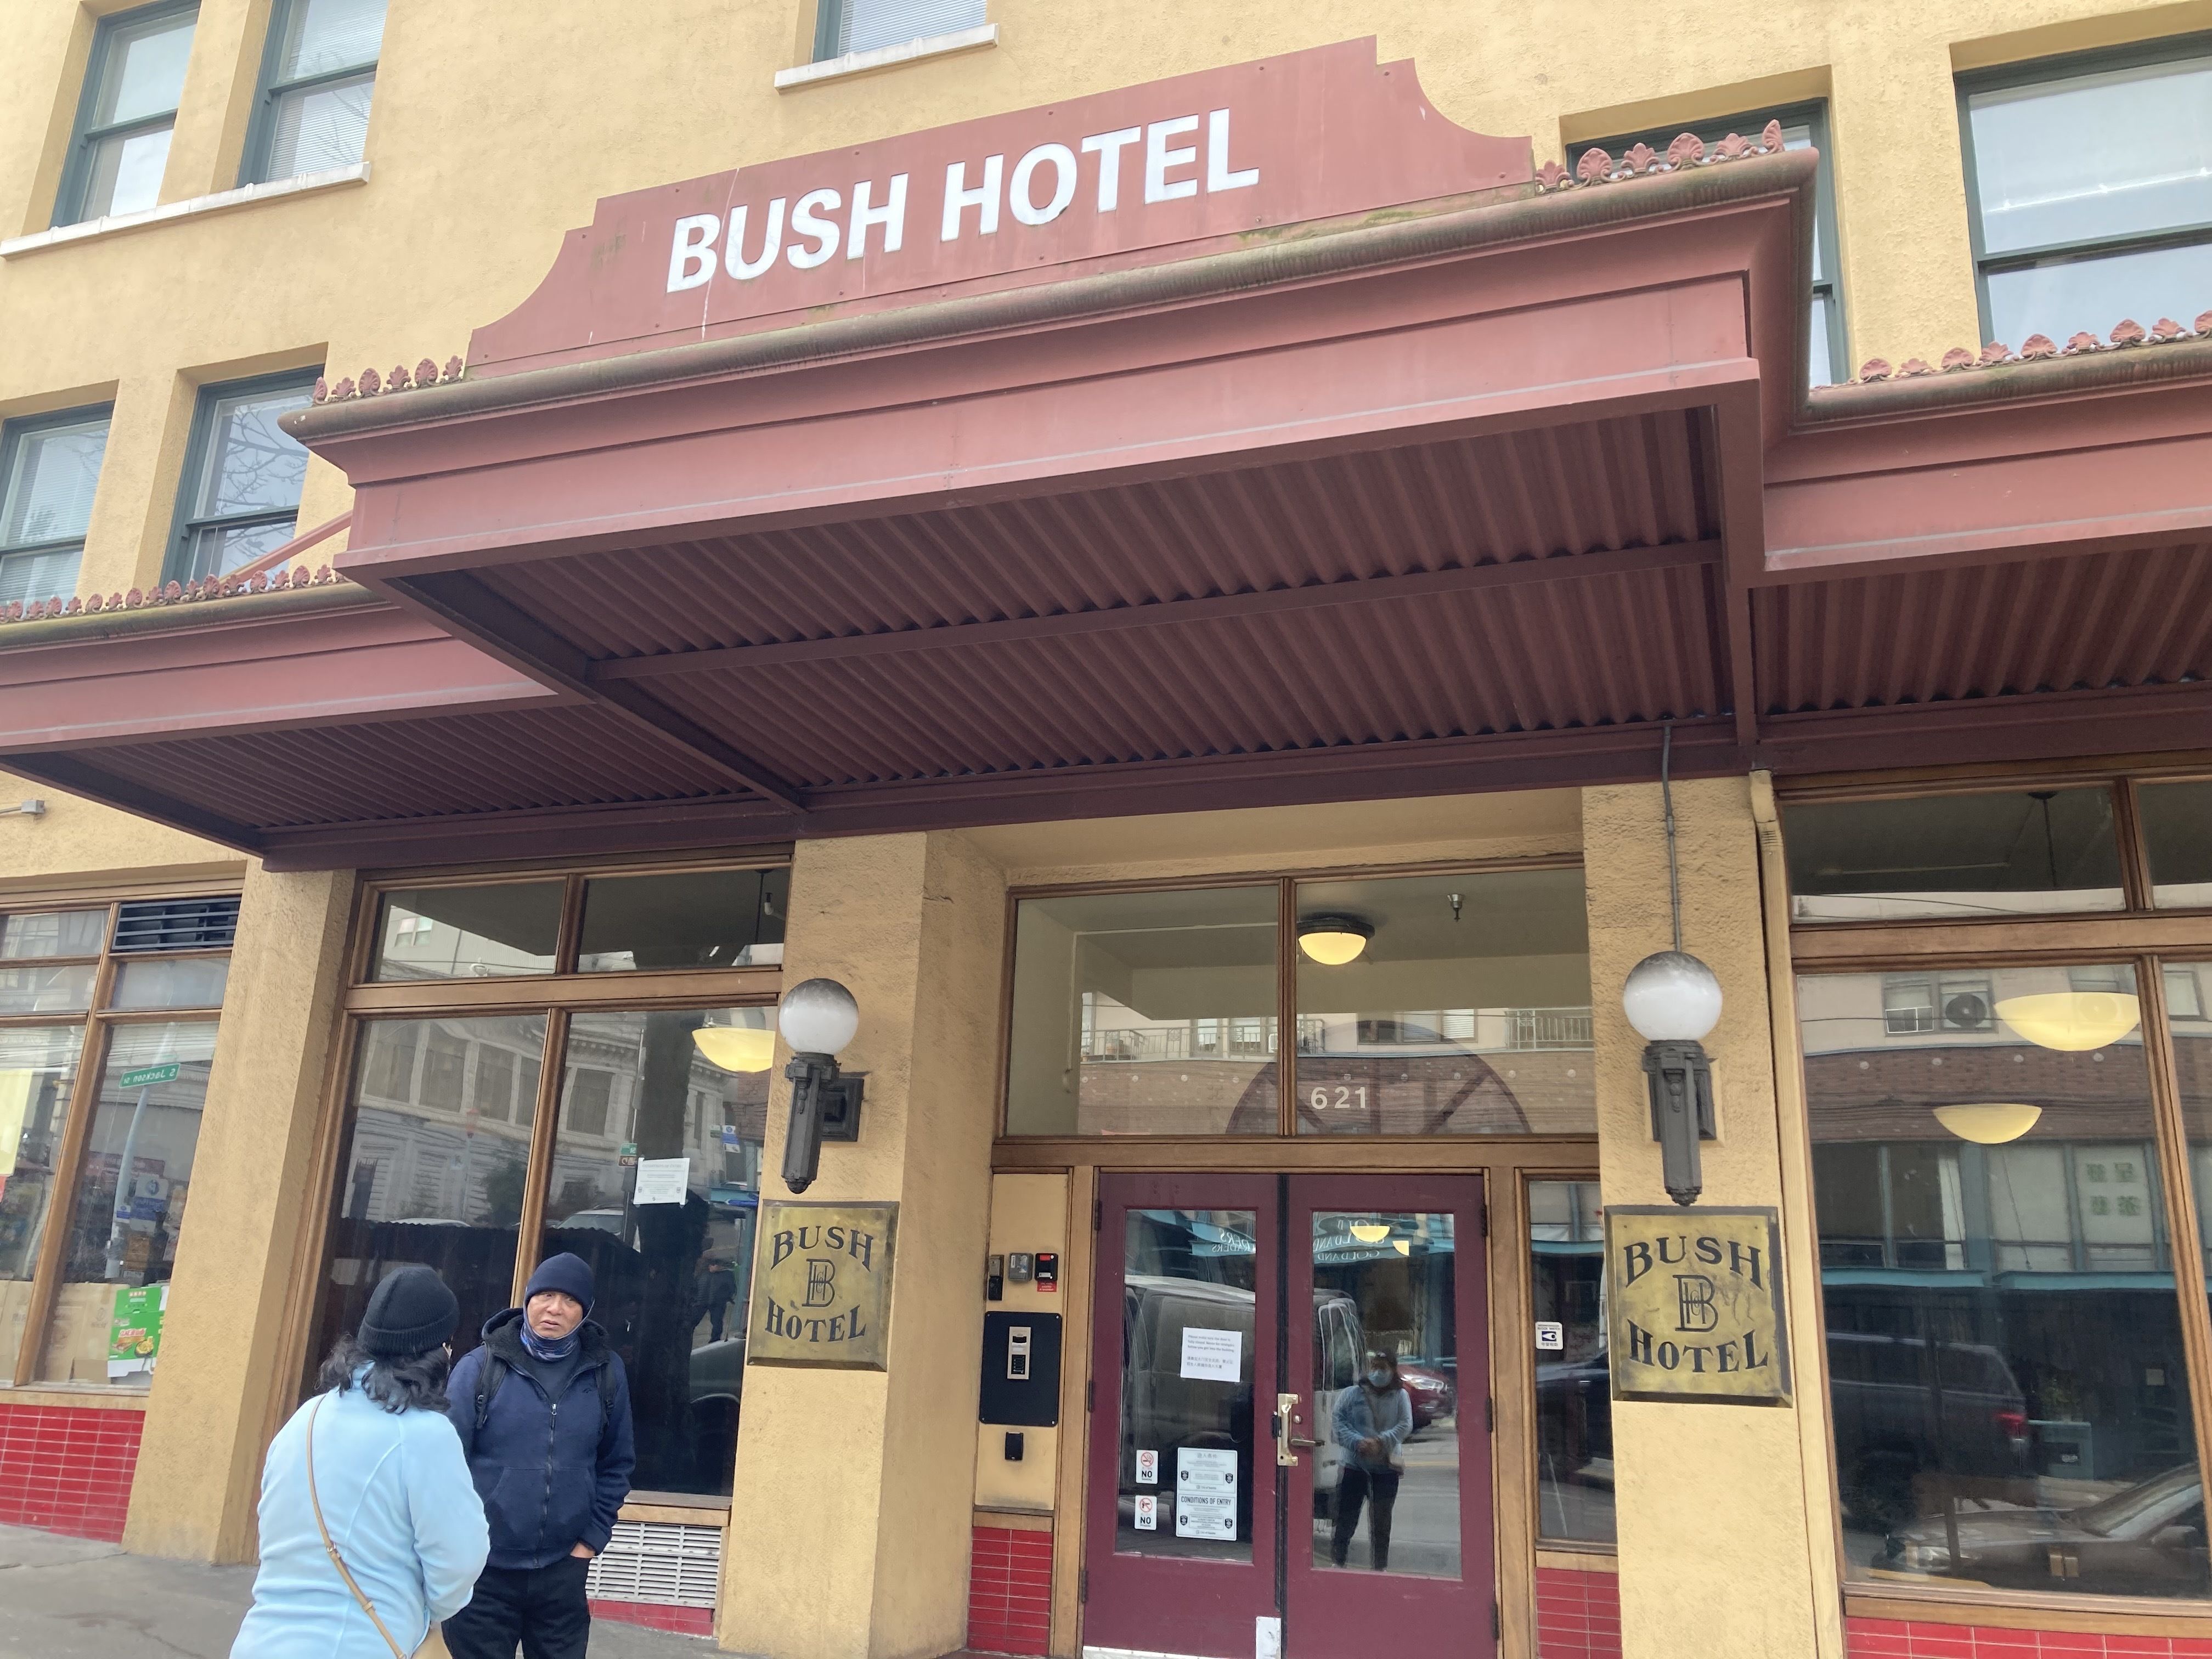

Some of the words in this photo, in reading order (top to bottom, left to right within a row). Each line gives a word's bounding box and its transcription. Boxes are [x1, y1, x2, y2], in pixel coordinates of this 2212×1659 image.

[666, 172, 909, 293] BUSH
[940, 108, 1260, 242] HOTEL
[1311, 1086, 1365, 1109] 621
[770, 1225, 874, 1273] BUSH
[1623, 1235, 1765, 1292] BUSH
[765, 1296, 867, 1342] HOTEL
[1626, 1318, 1769, 1373] HOTEL
